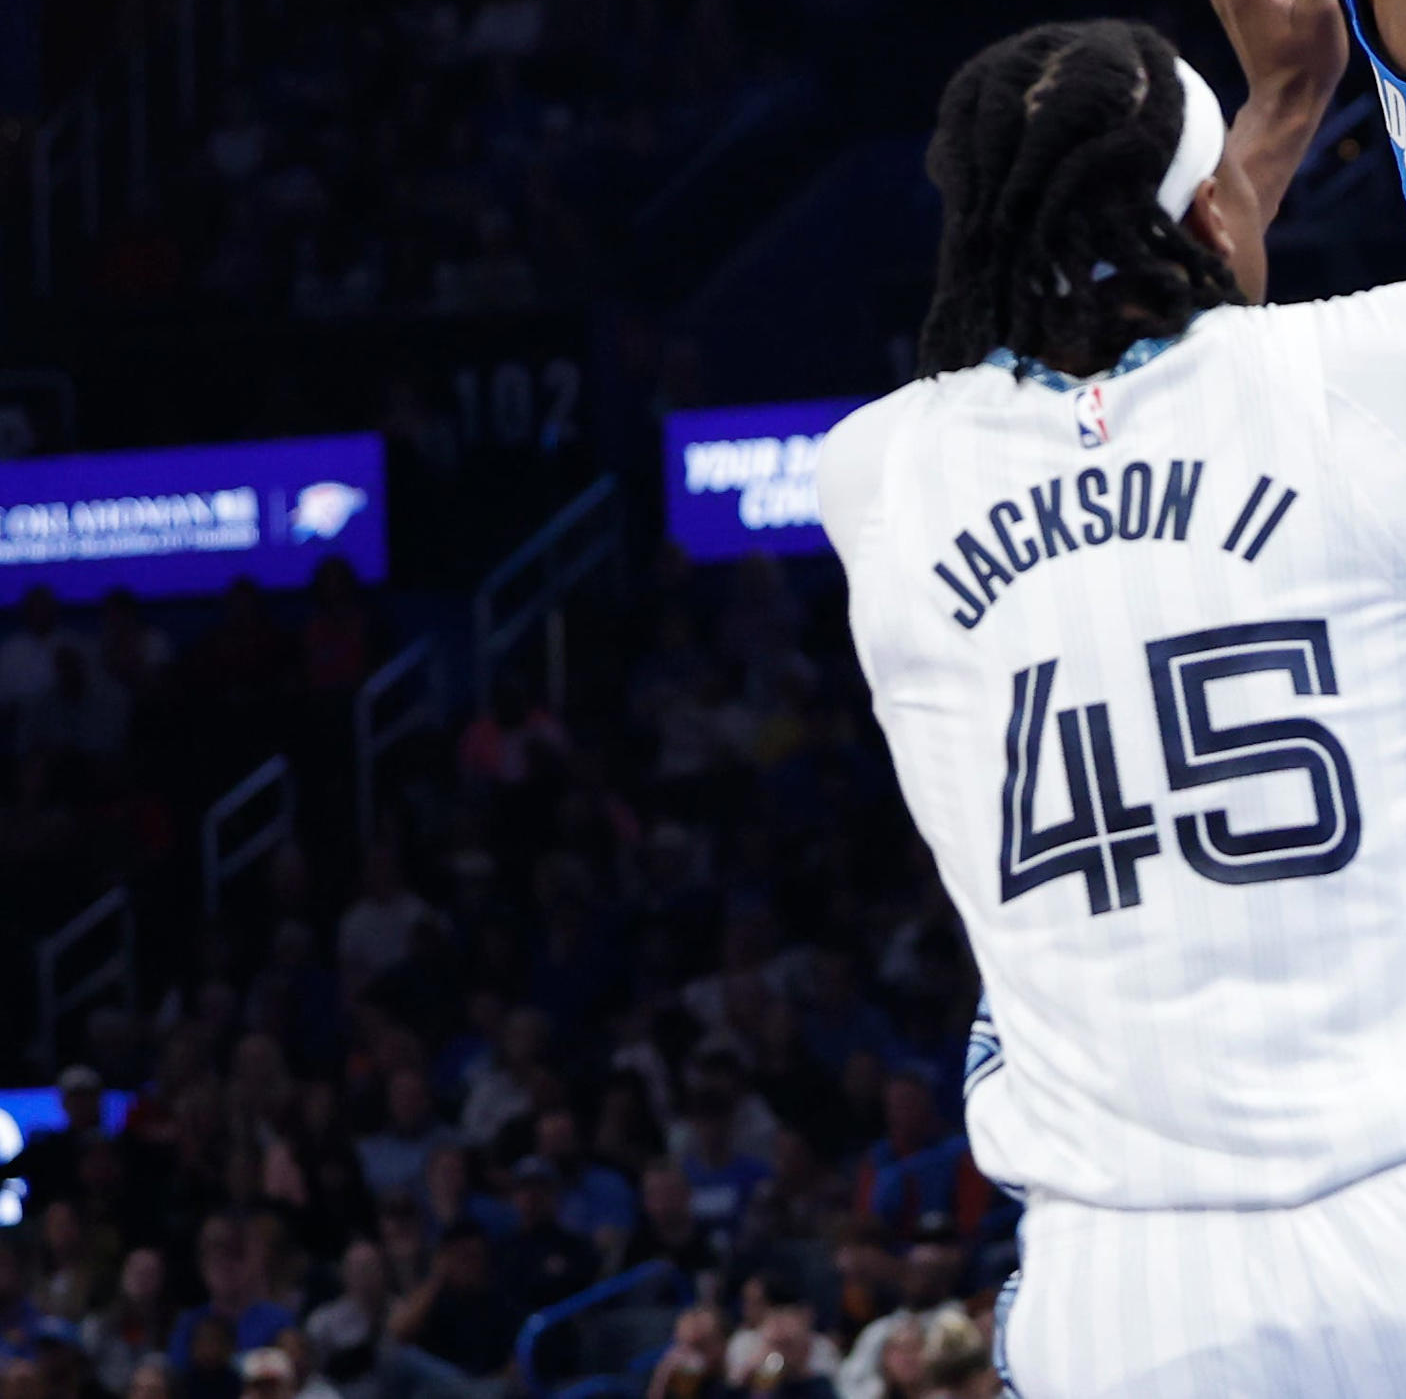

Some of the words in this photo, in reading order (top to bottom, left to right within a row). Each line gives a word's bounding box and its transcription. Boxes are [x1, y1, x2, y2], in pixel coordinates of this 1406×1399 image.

[452, 356, 583, 443] 102
[933, 459, 1204, 630] JACKSON
[1222, 475, 1298, 562] II
[1001, 618, 1361, 916] 45
